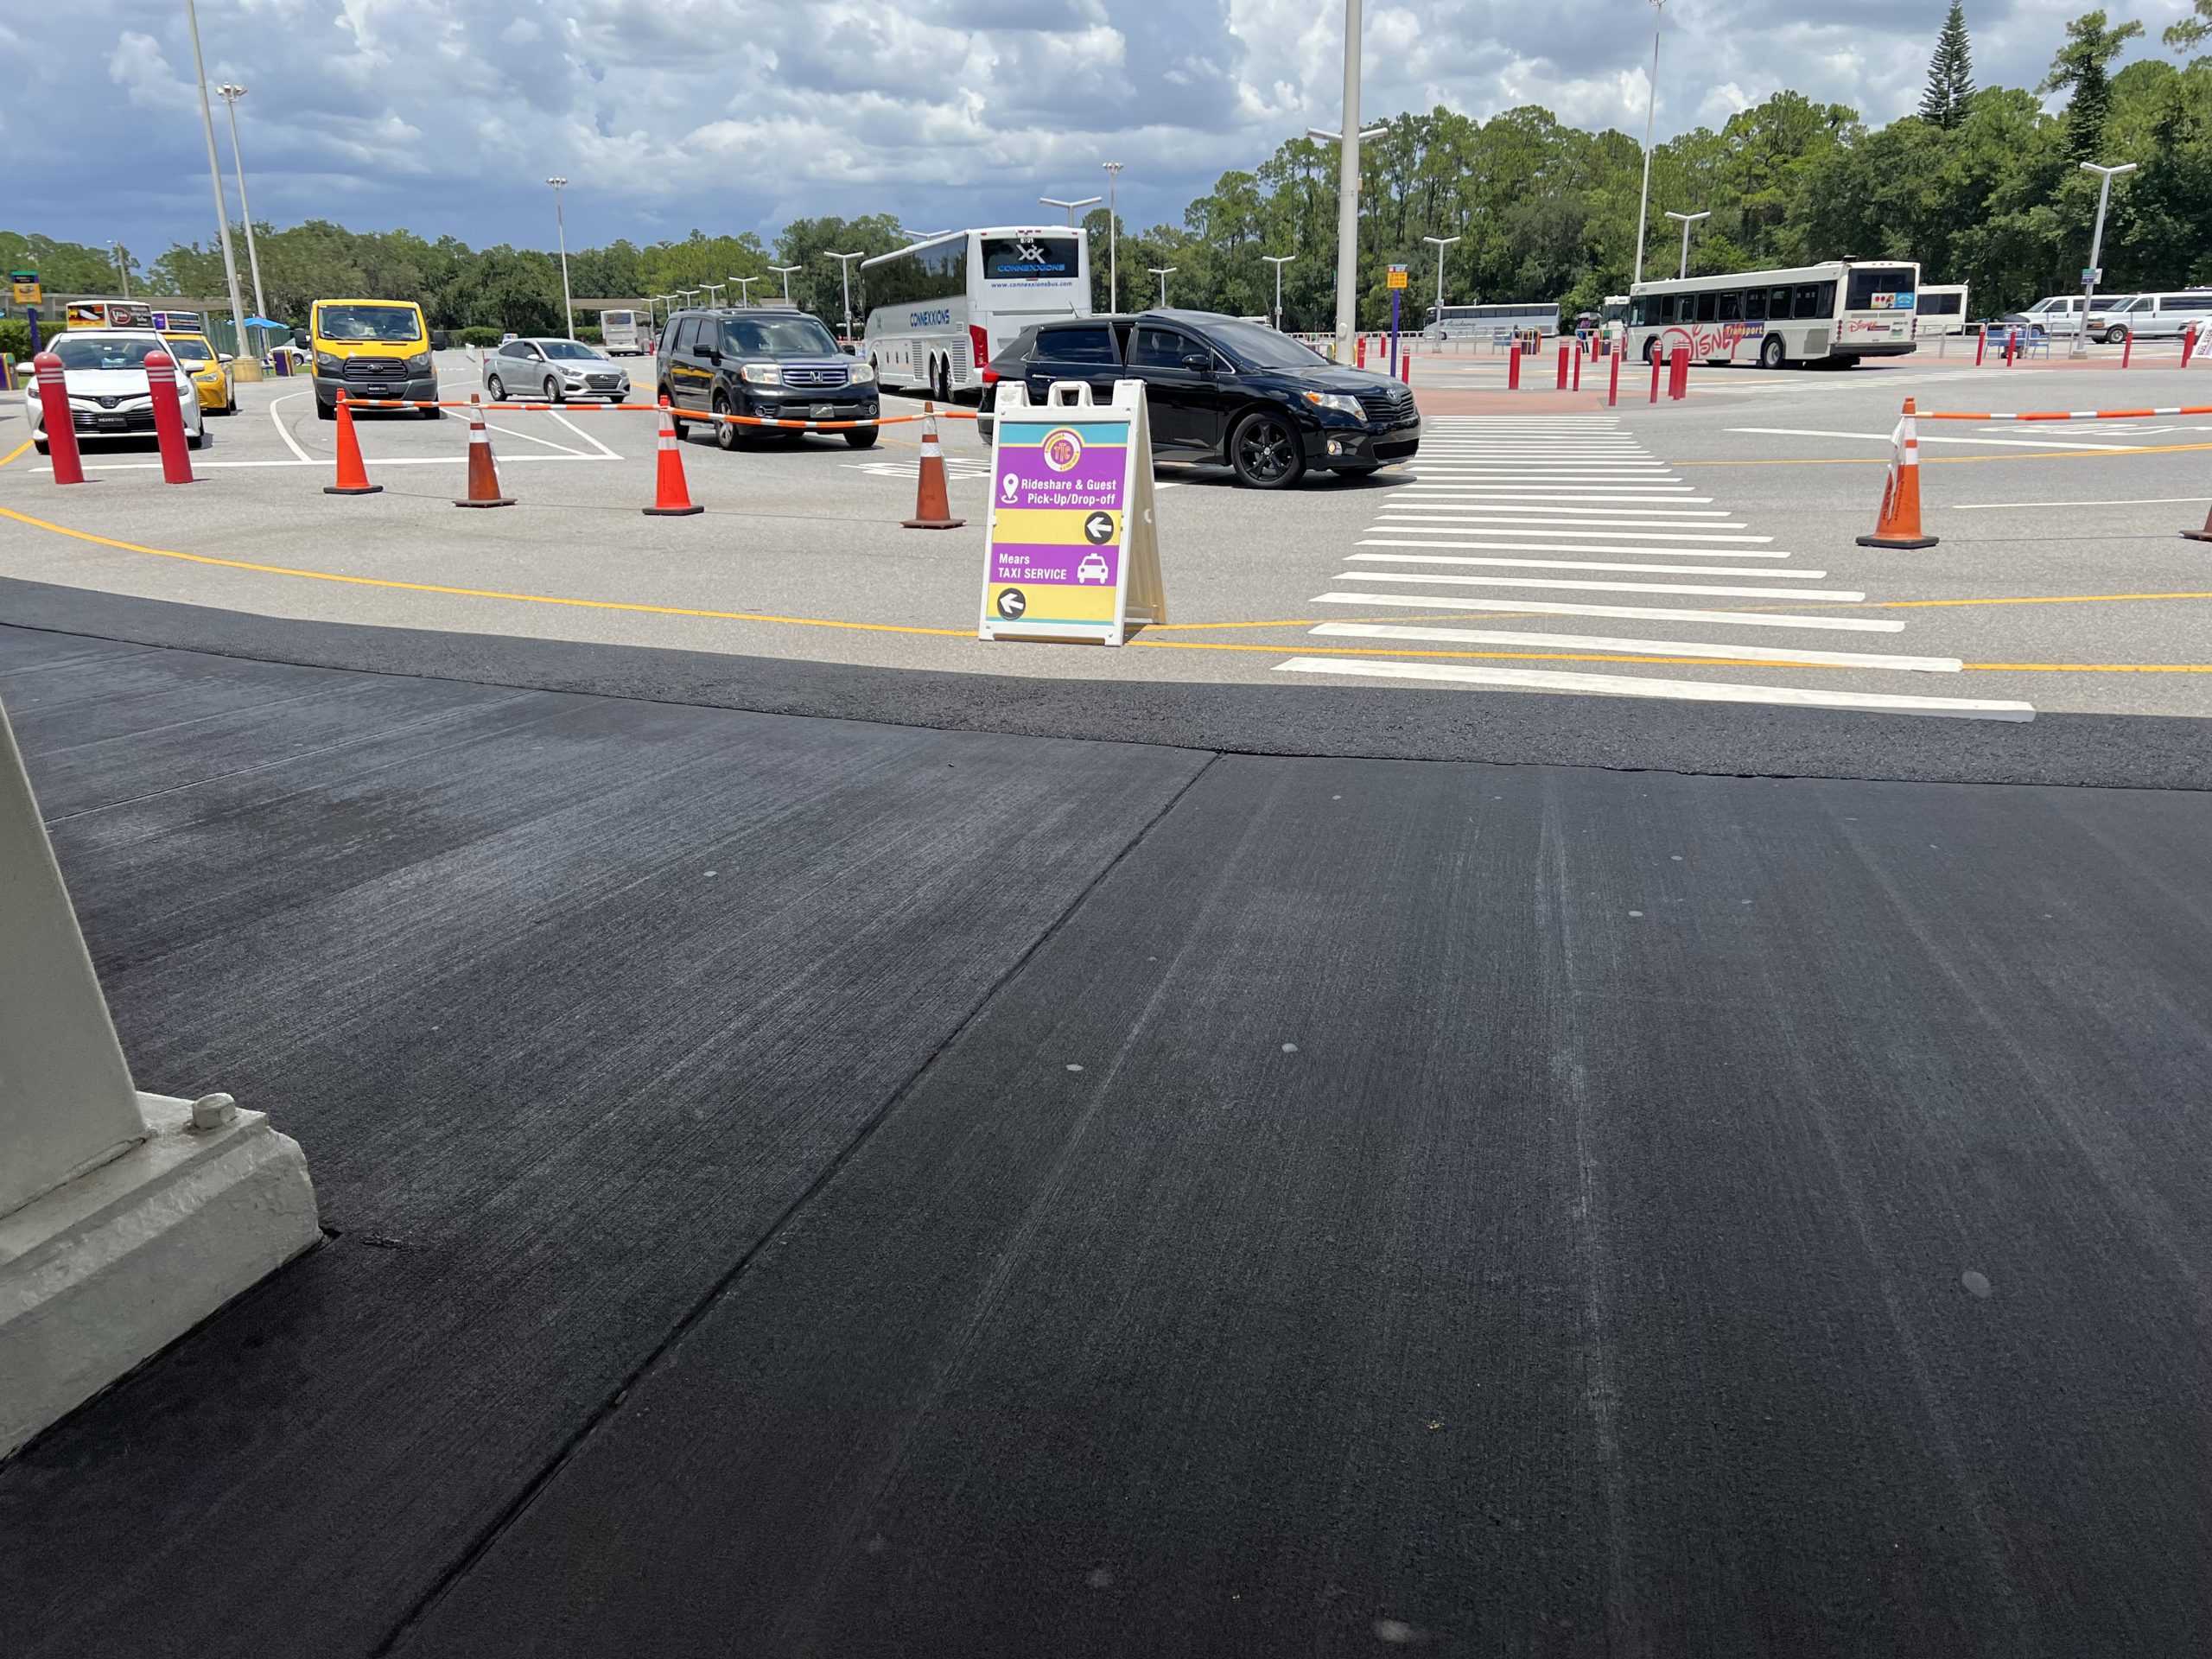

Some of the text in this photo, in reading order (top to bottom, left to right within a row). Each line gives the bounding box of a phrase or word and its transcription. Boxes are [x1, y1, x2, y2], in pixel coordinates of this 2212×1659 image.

[997, 264, 1065, 272] CONNEXXIONS
[910, 308, 950, 327] CONNEXXIONS
[1053, 442, 1071, 462] TTC
[1020, 479, 1116, 490] Rideshare & Guest
[1027, 493, 1116, 506] Pick-Up/Drop-off
[999, 553, 1030, 564] Mears
[998, 567, 1067, 580] TAXI SERVICE
